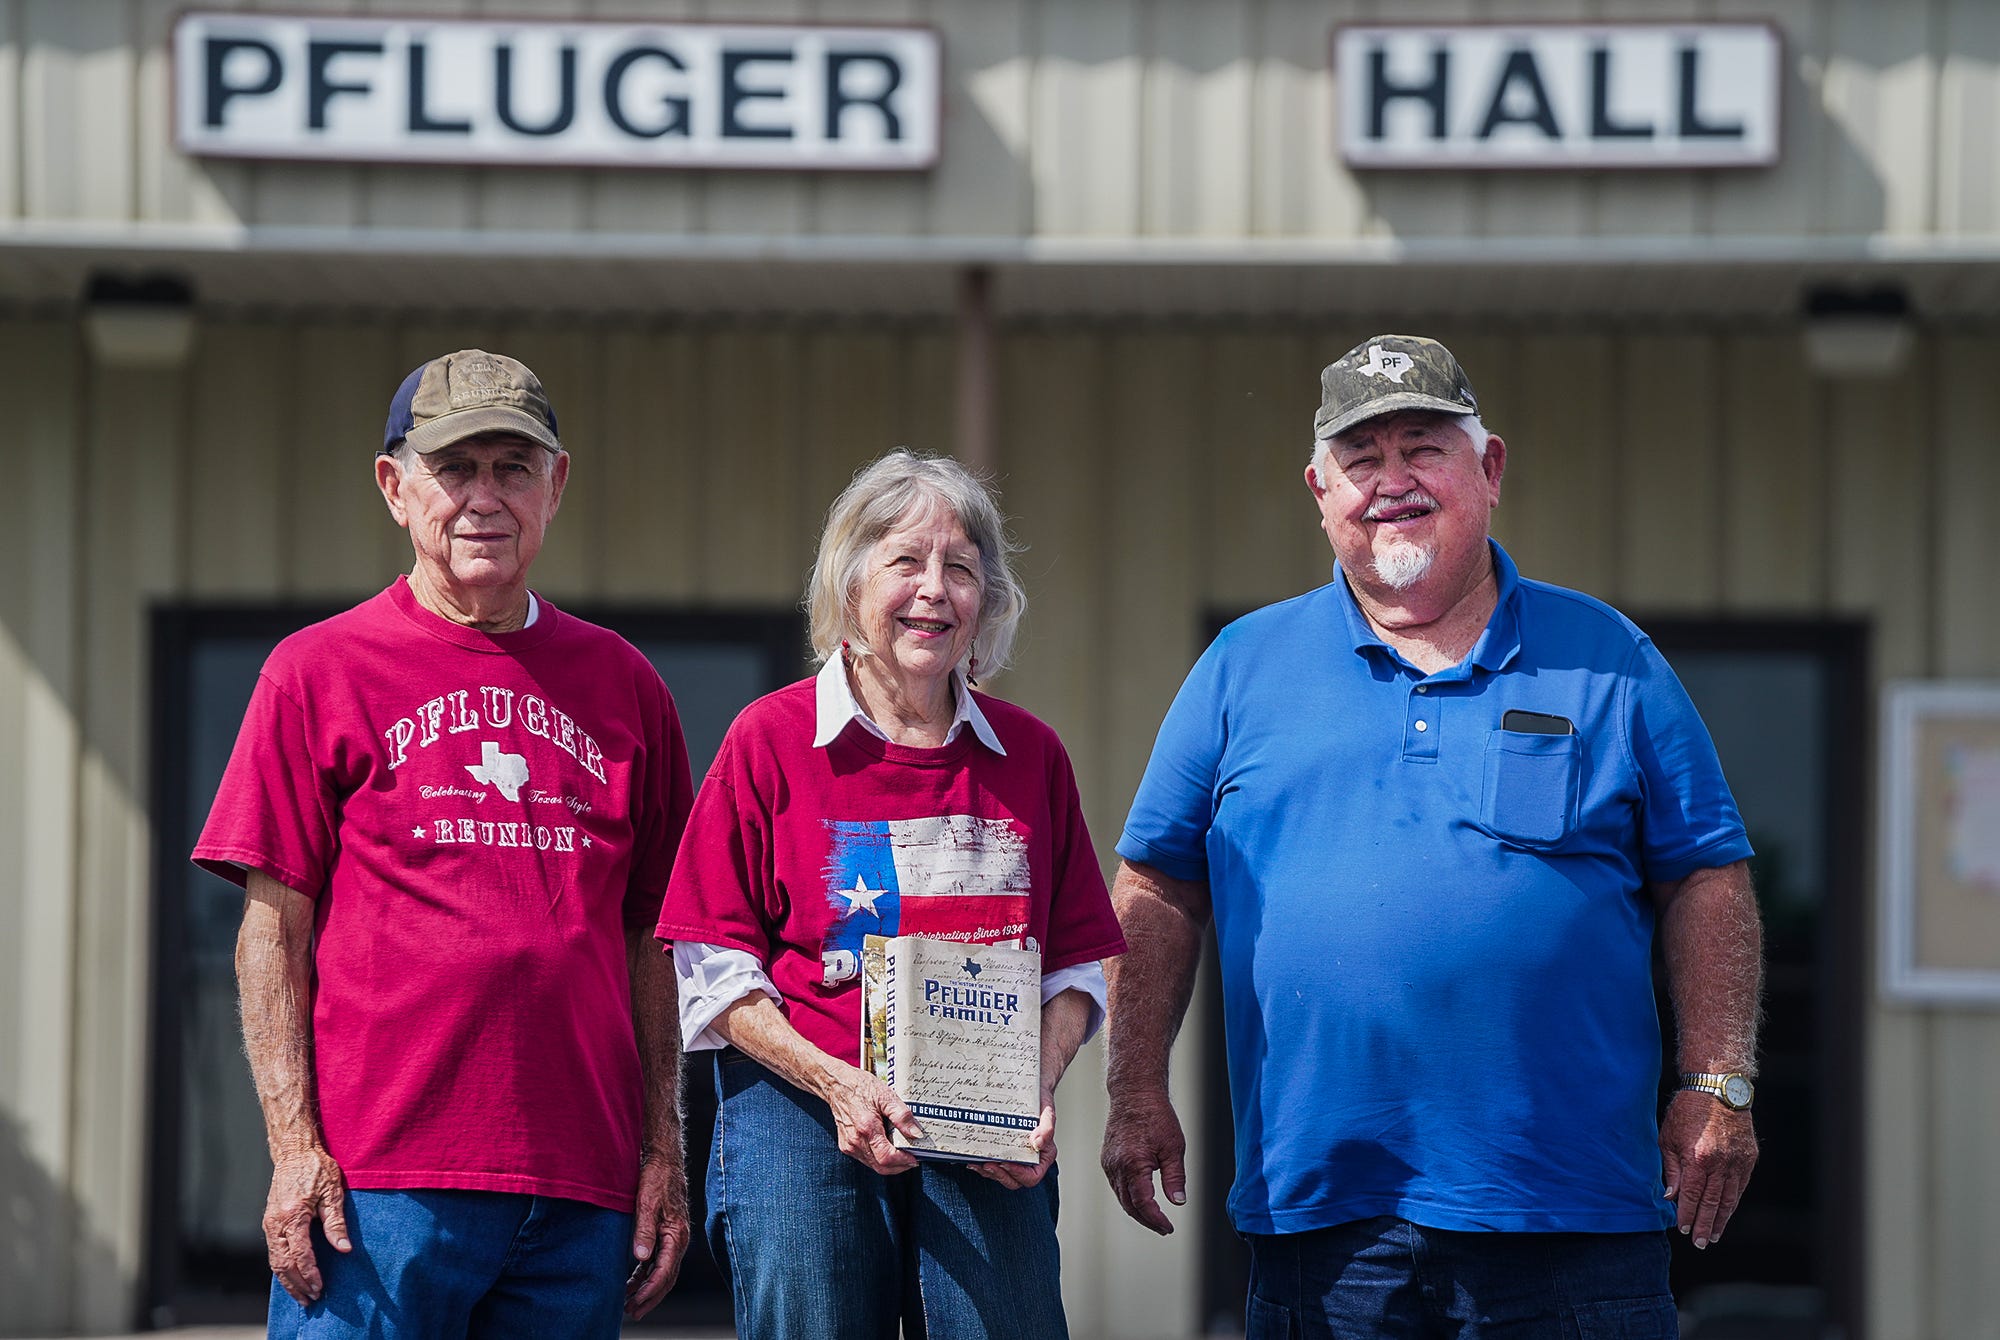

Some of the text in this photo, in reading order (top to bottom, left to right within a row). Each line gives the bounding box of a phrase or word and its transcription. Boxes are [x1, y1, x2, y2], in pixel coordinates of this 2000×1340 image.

[203, 36, 905, 141] PFLUGER
[1367, 46, 1746, 140] HALL
[1381, 357, 1402, 369] PF
[385, 686, 608, 785] PFLUGER
[419, 785, 592, 815] Celebrating Texas Style
[434, 818, 576, 852] REUNION
[973, 927, 1000, 941] Since
[924, 978, 1019, 1012] PFLUGER
[886, 954, 896, 1091] PFLUGER FAM
[929, 1004, 1014, 1026] FAMILY
[964, 1111, 985, 1122] FROM
[987, 1114, 1005, 1124] 1803
[1007, 1117, 1017, 1126] TO
[1018, 1118, 1038, 1128] 2020
